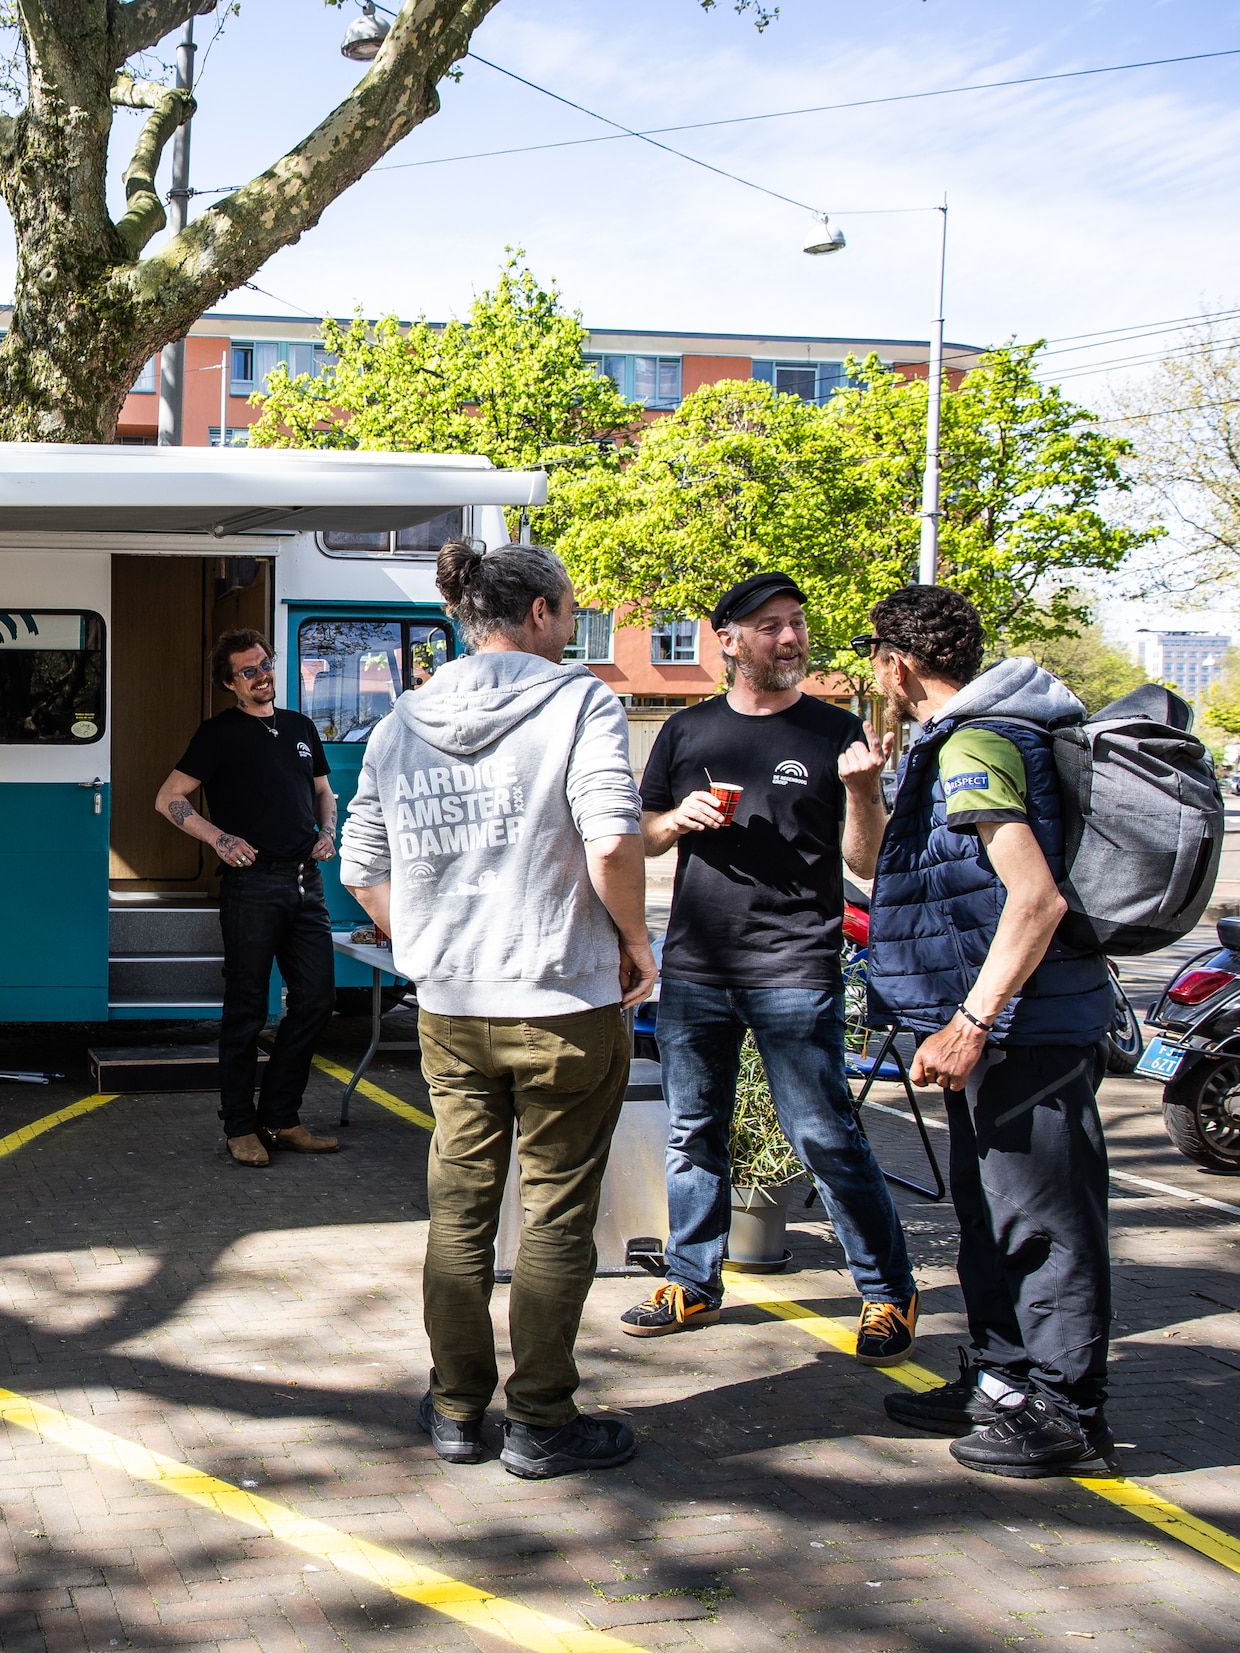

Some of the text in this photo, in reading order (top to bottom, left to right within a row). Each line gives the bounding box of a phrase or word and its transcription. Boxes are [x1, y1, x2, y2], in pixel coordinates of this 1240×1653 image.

[395, 756, 518, 801] AARDIGE
[951, 776, 987, 789] RESPECT
[396, 787, 512, 831] AMSTER
[398, 816, 526, 860] DAMMER
[1151, 1057, 1176, 1073] 6ZT
